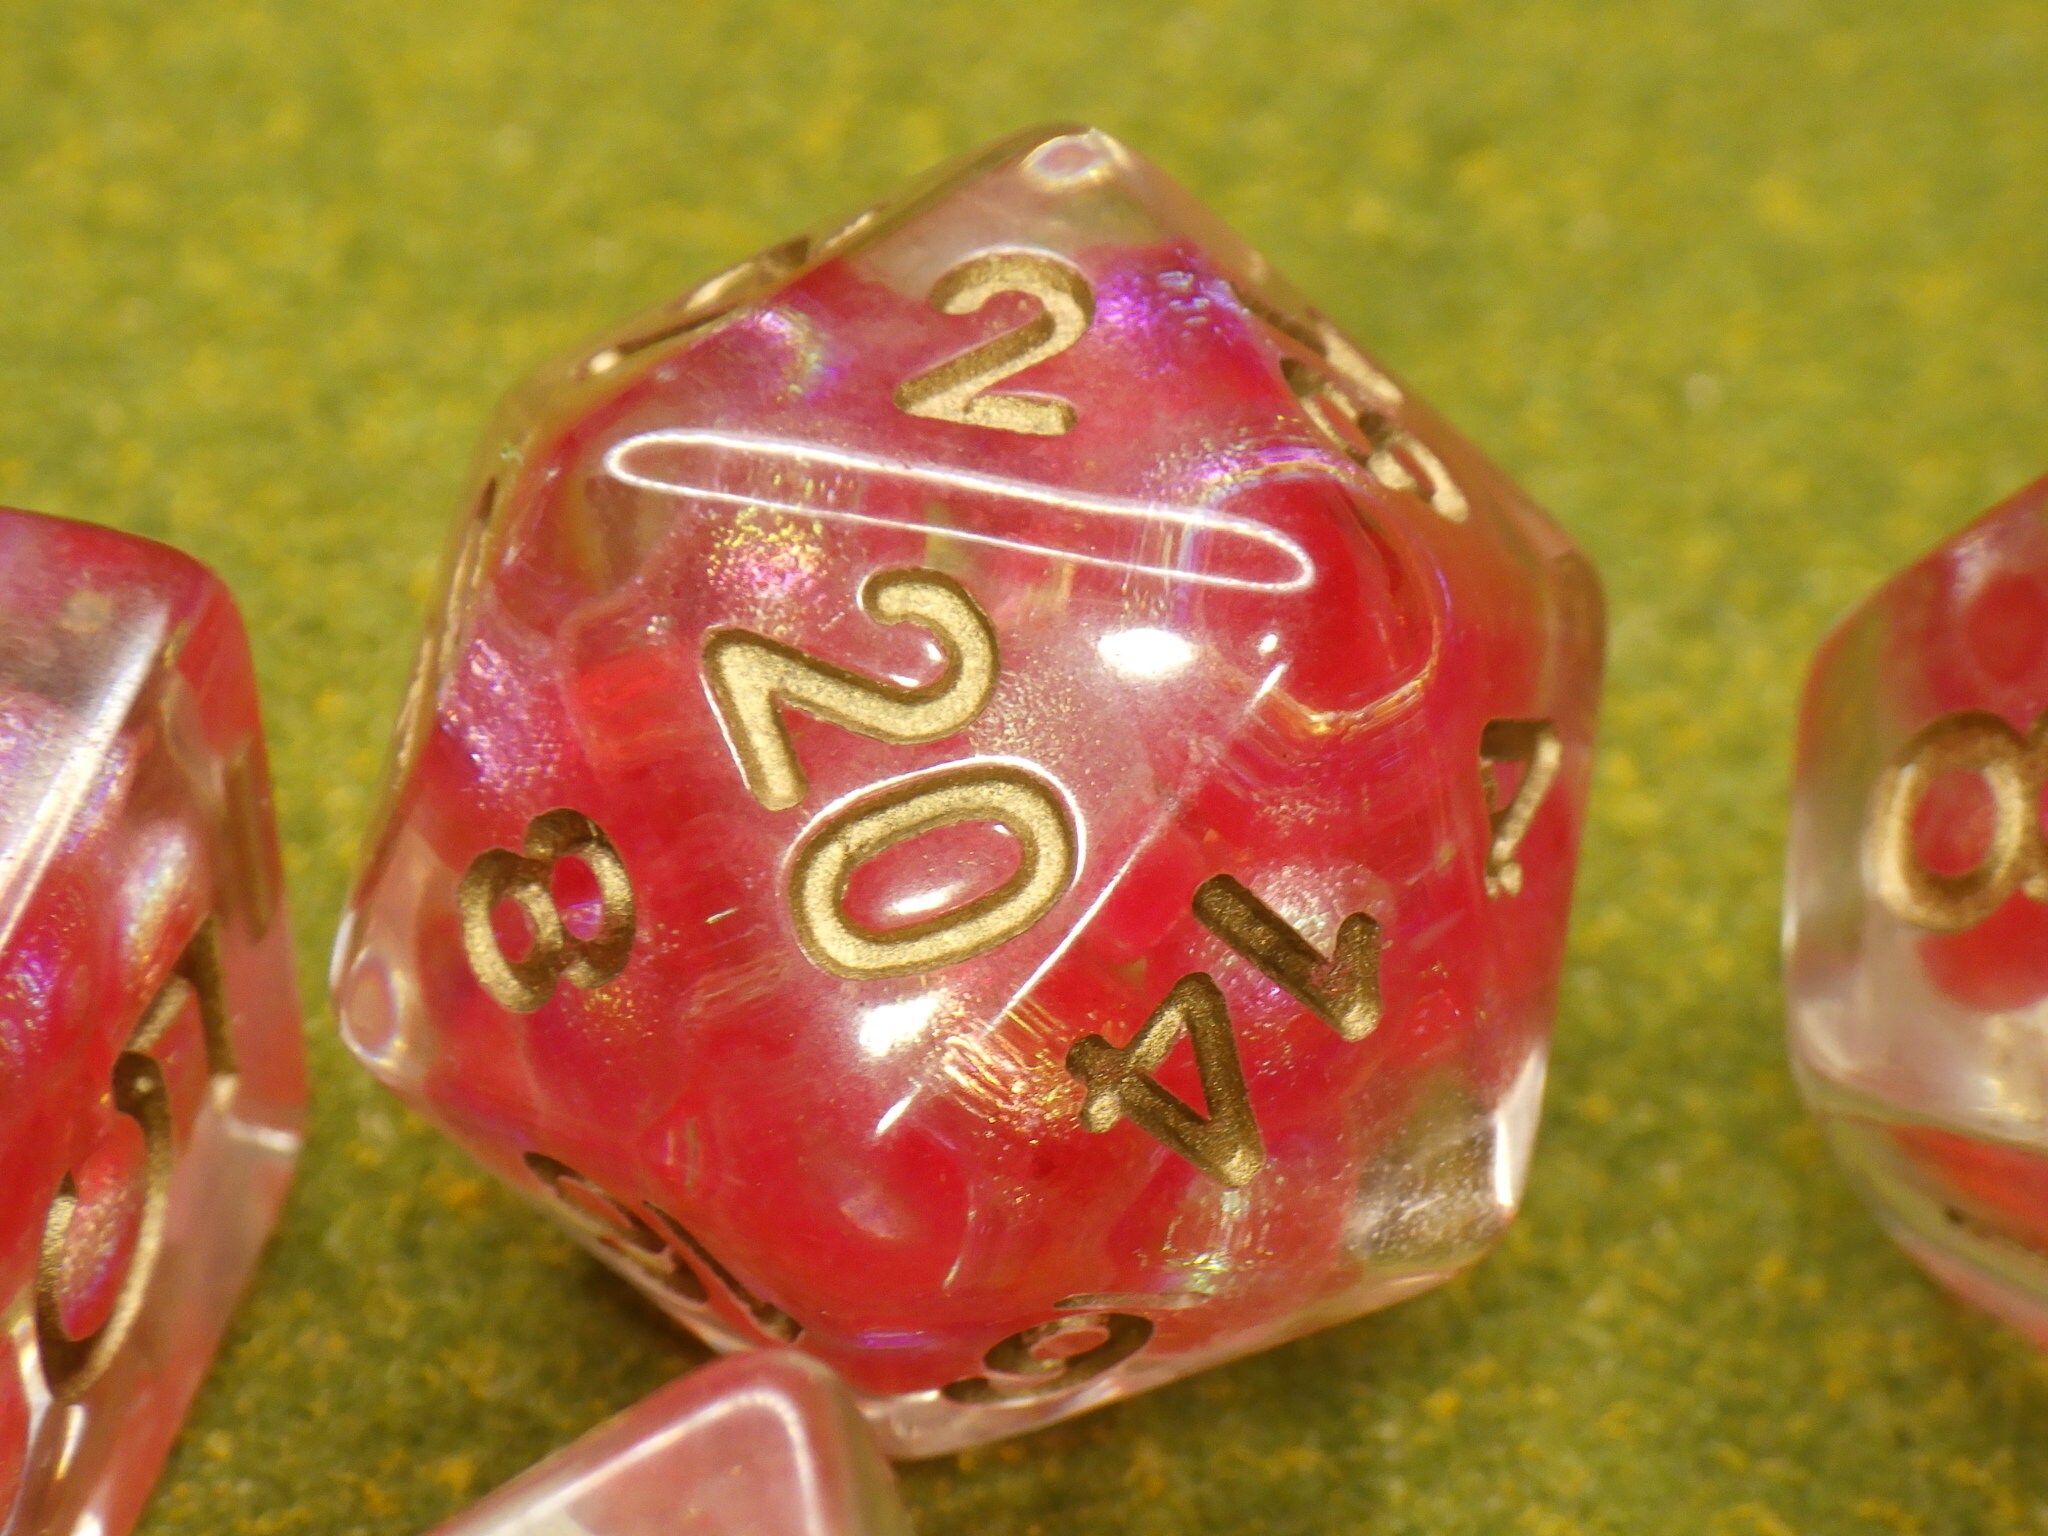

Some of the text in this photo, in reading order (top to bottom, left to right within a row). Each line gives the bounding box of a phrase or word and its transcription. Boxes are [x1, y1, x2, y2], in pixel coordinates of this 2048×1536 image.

[895, 247, 1093, 435] 2
[703, 566, 1078, 981] 20
[457, 807, 636, 1013] 8
[1066, 873, 1381, 1188] 14
